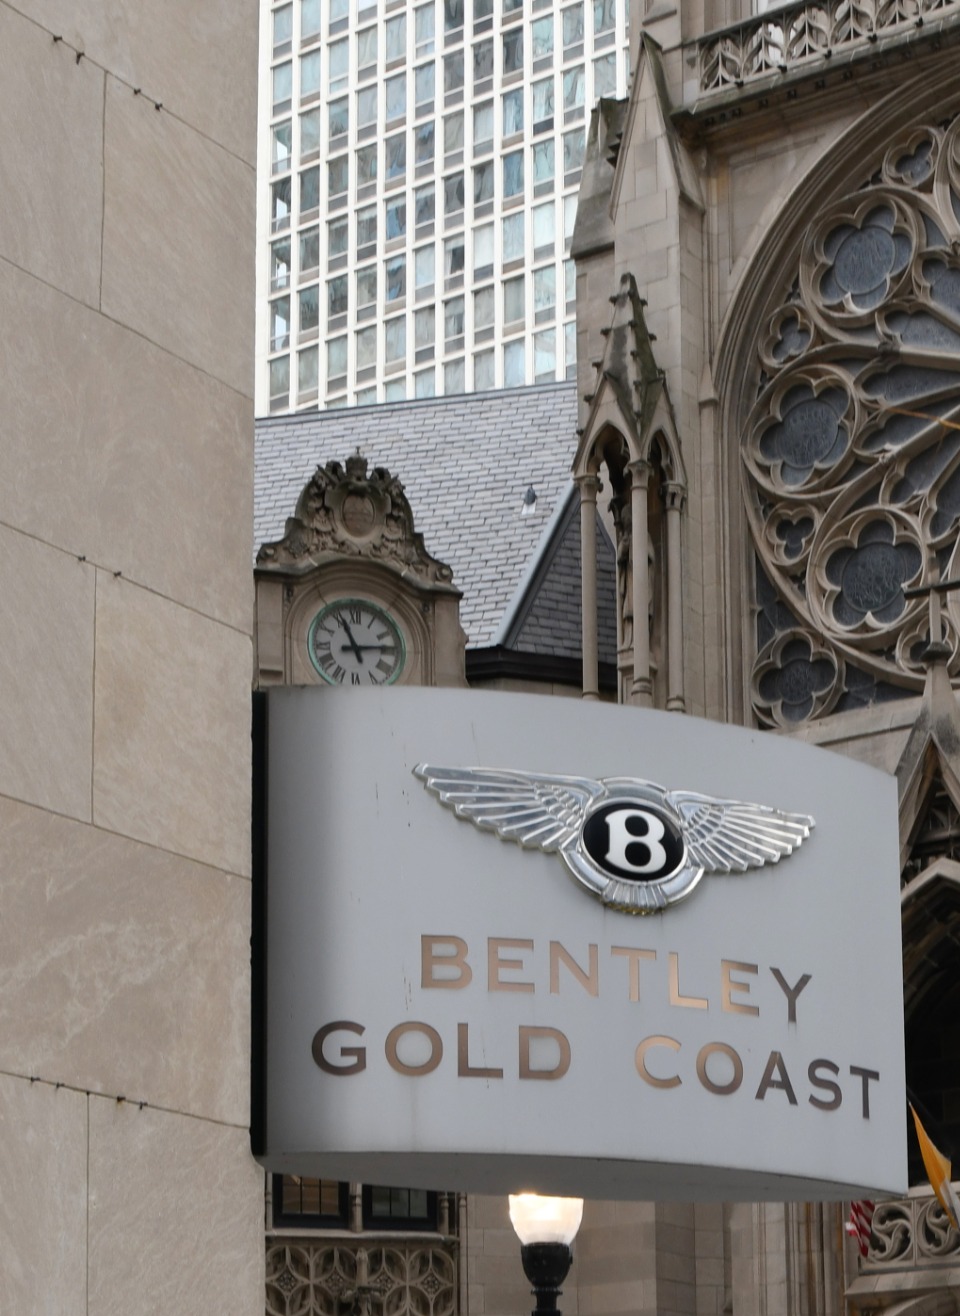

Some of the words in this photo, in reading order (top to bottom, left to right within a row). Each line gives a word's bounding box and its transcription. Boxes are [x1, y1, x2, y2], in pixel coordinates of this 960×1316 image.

[605, 807, 666, 875] B
[420, 934, 813, 1023] BENTLEY
[311, 1020, 572, 1081] GOLD
[634, 1035, 880, 1120] COAST
